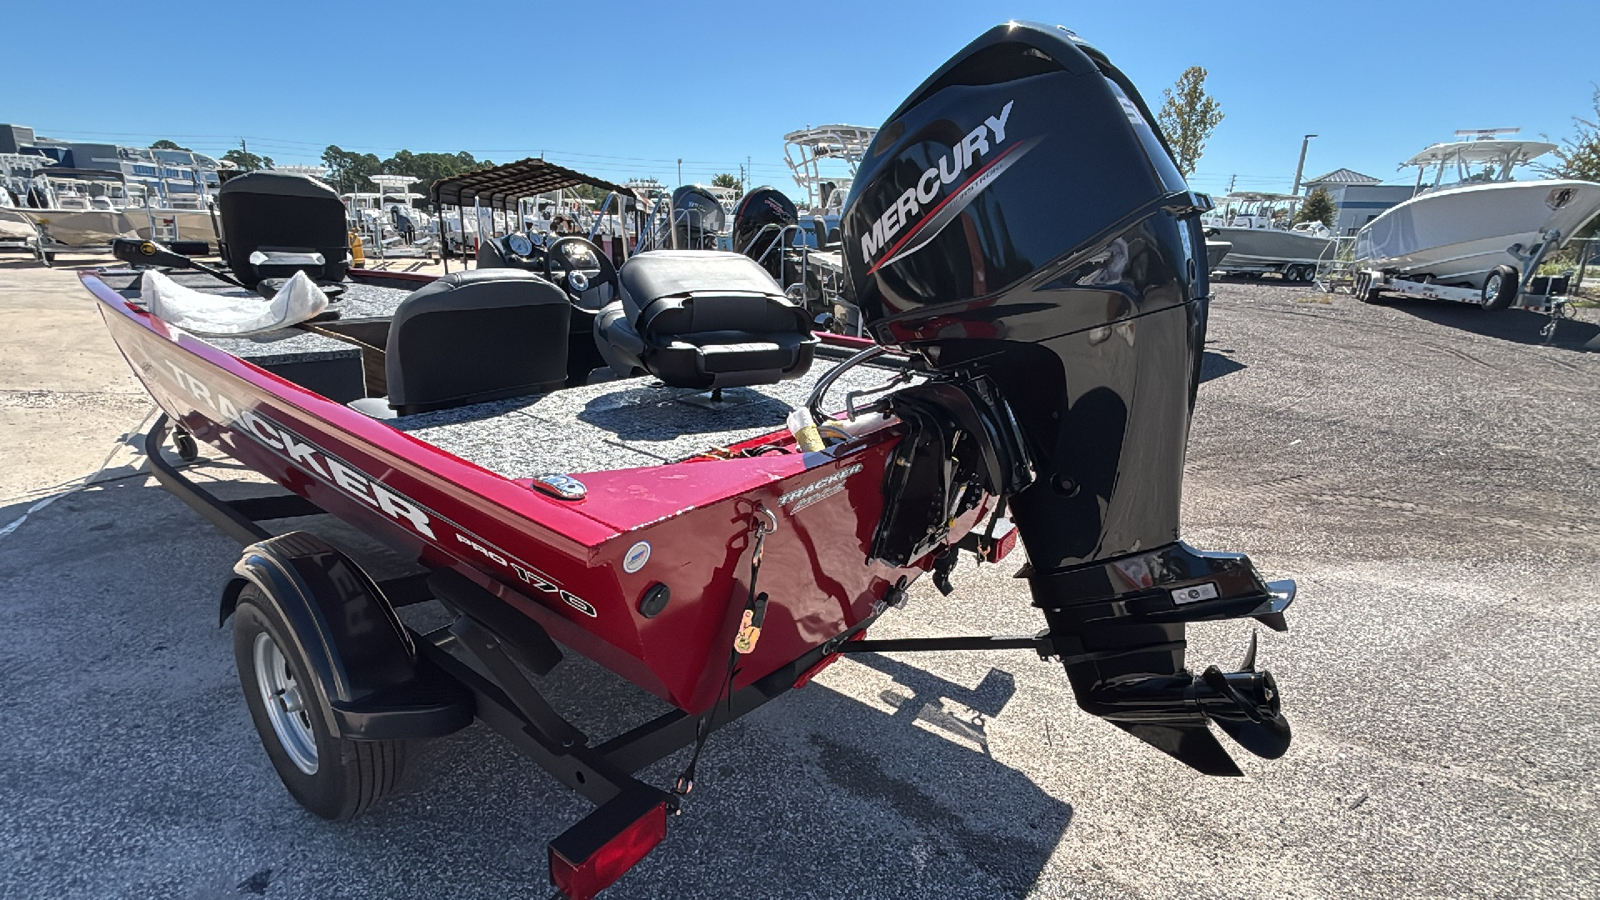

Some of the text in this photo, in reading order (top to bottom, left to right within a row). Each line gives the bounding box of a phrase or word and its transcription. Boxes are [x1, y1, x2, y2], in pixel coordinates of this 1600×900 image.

[861, 100, 1014, 264] MERCURY
[165, 359, 437, 540] TRACKER
[455, 532, 508, 567] PRO
[778, 462, 864, 507] TRACKER
